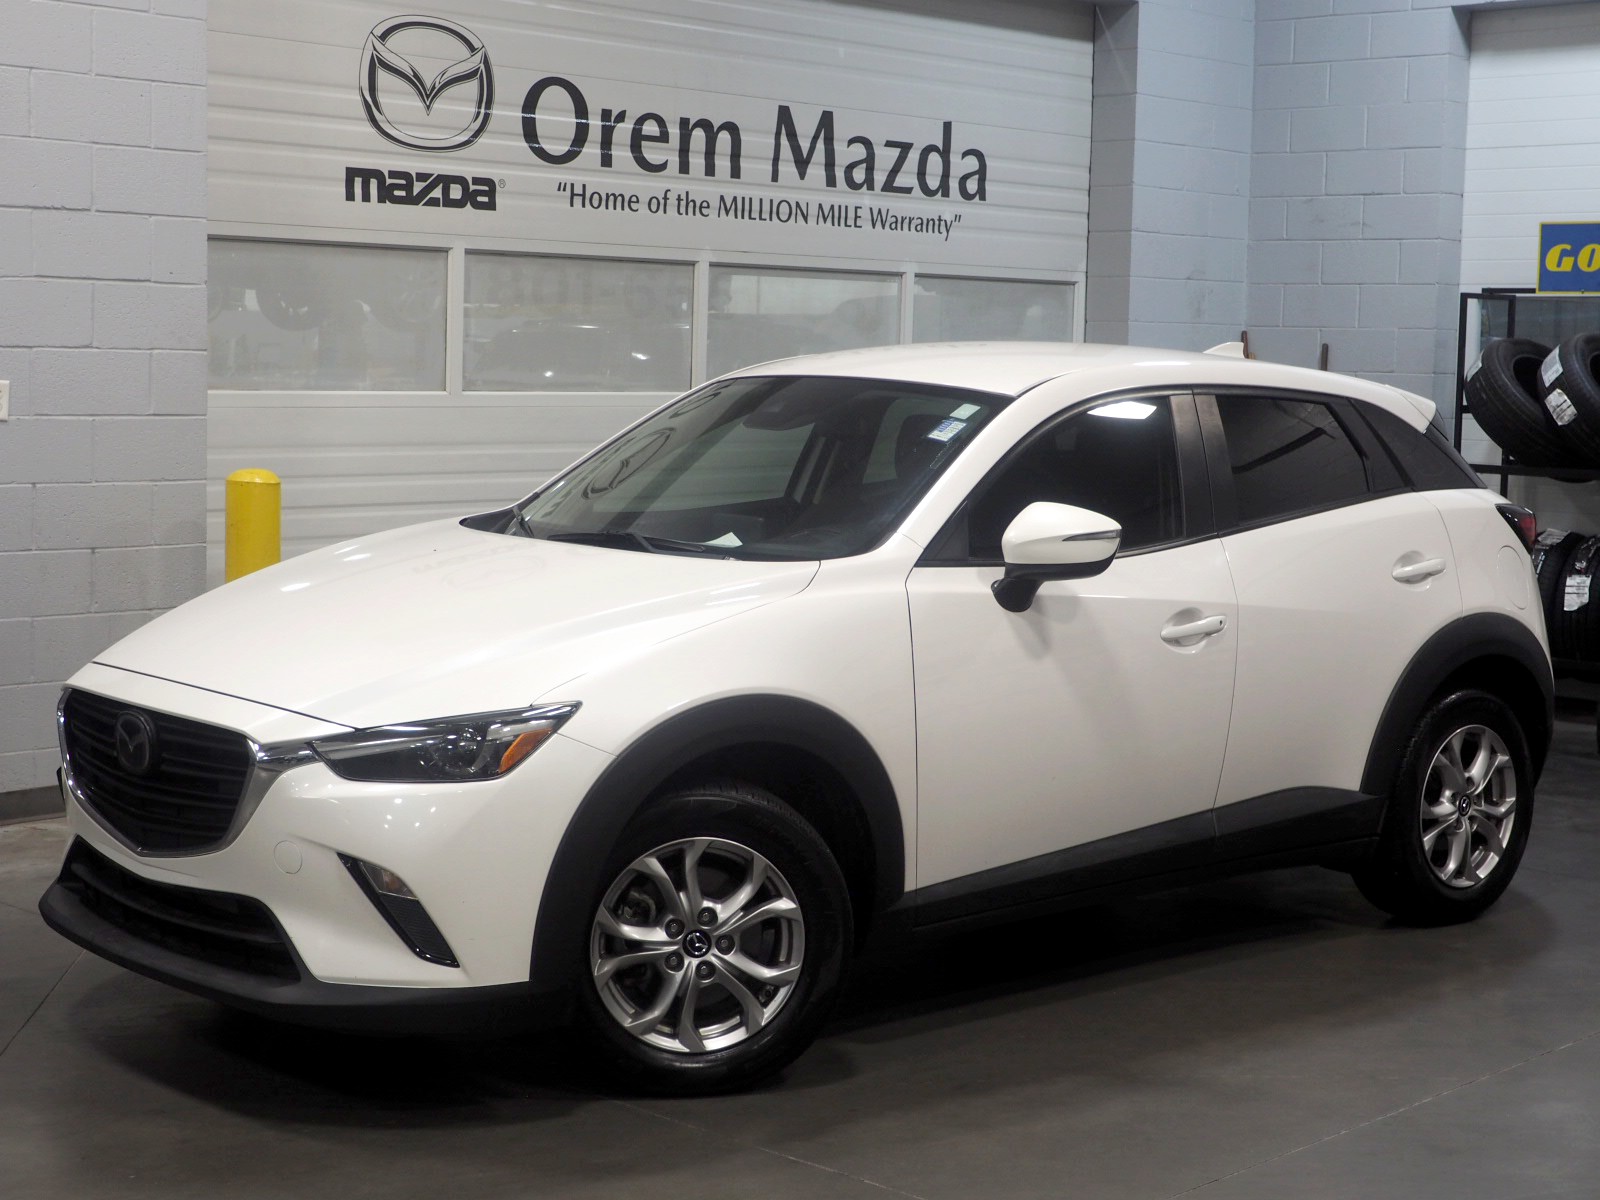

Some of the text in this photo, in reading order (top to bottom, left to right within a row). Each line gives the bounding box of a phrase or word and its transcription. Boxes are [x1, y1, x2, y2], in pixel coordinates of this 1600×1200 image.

[521, 76, 988, 203] Orem Mazda
[647, 188, 672, 215] of
[675, 190, 711, 218] the
[717, 194, 809, 225] MILLION
[816, 202, 863, 229] MILE
